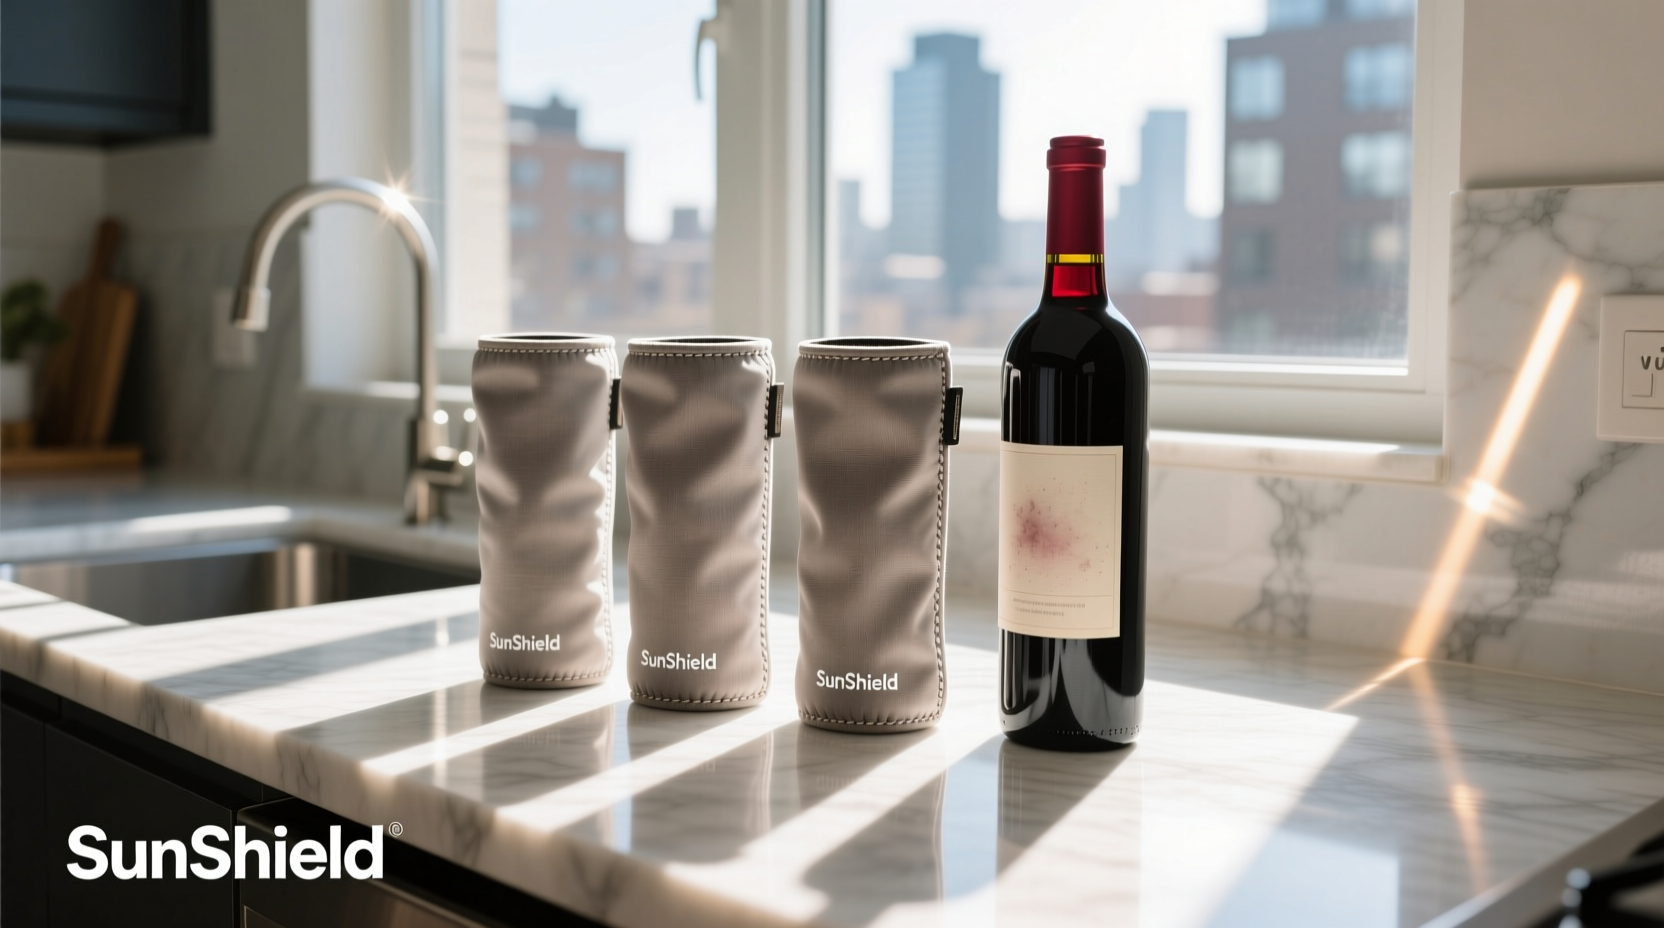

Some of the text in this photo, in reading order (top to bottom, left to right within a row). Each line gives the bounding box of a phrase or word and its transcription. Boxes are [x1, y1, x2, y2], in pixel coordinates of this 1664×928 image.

[489, 631, 560, 651] SunShield
[640, 649, 717, 670] SunShield
[816, 669, 898, 691] SunShield
